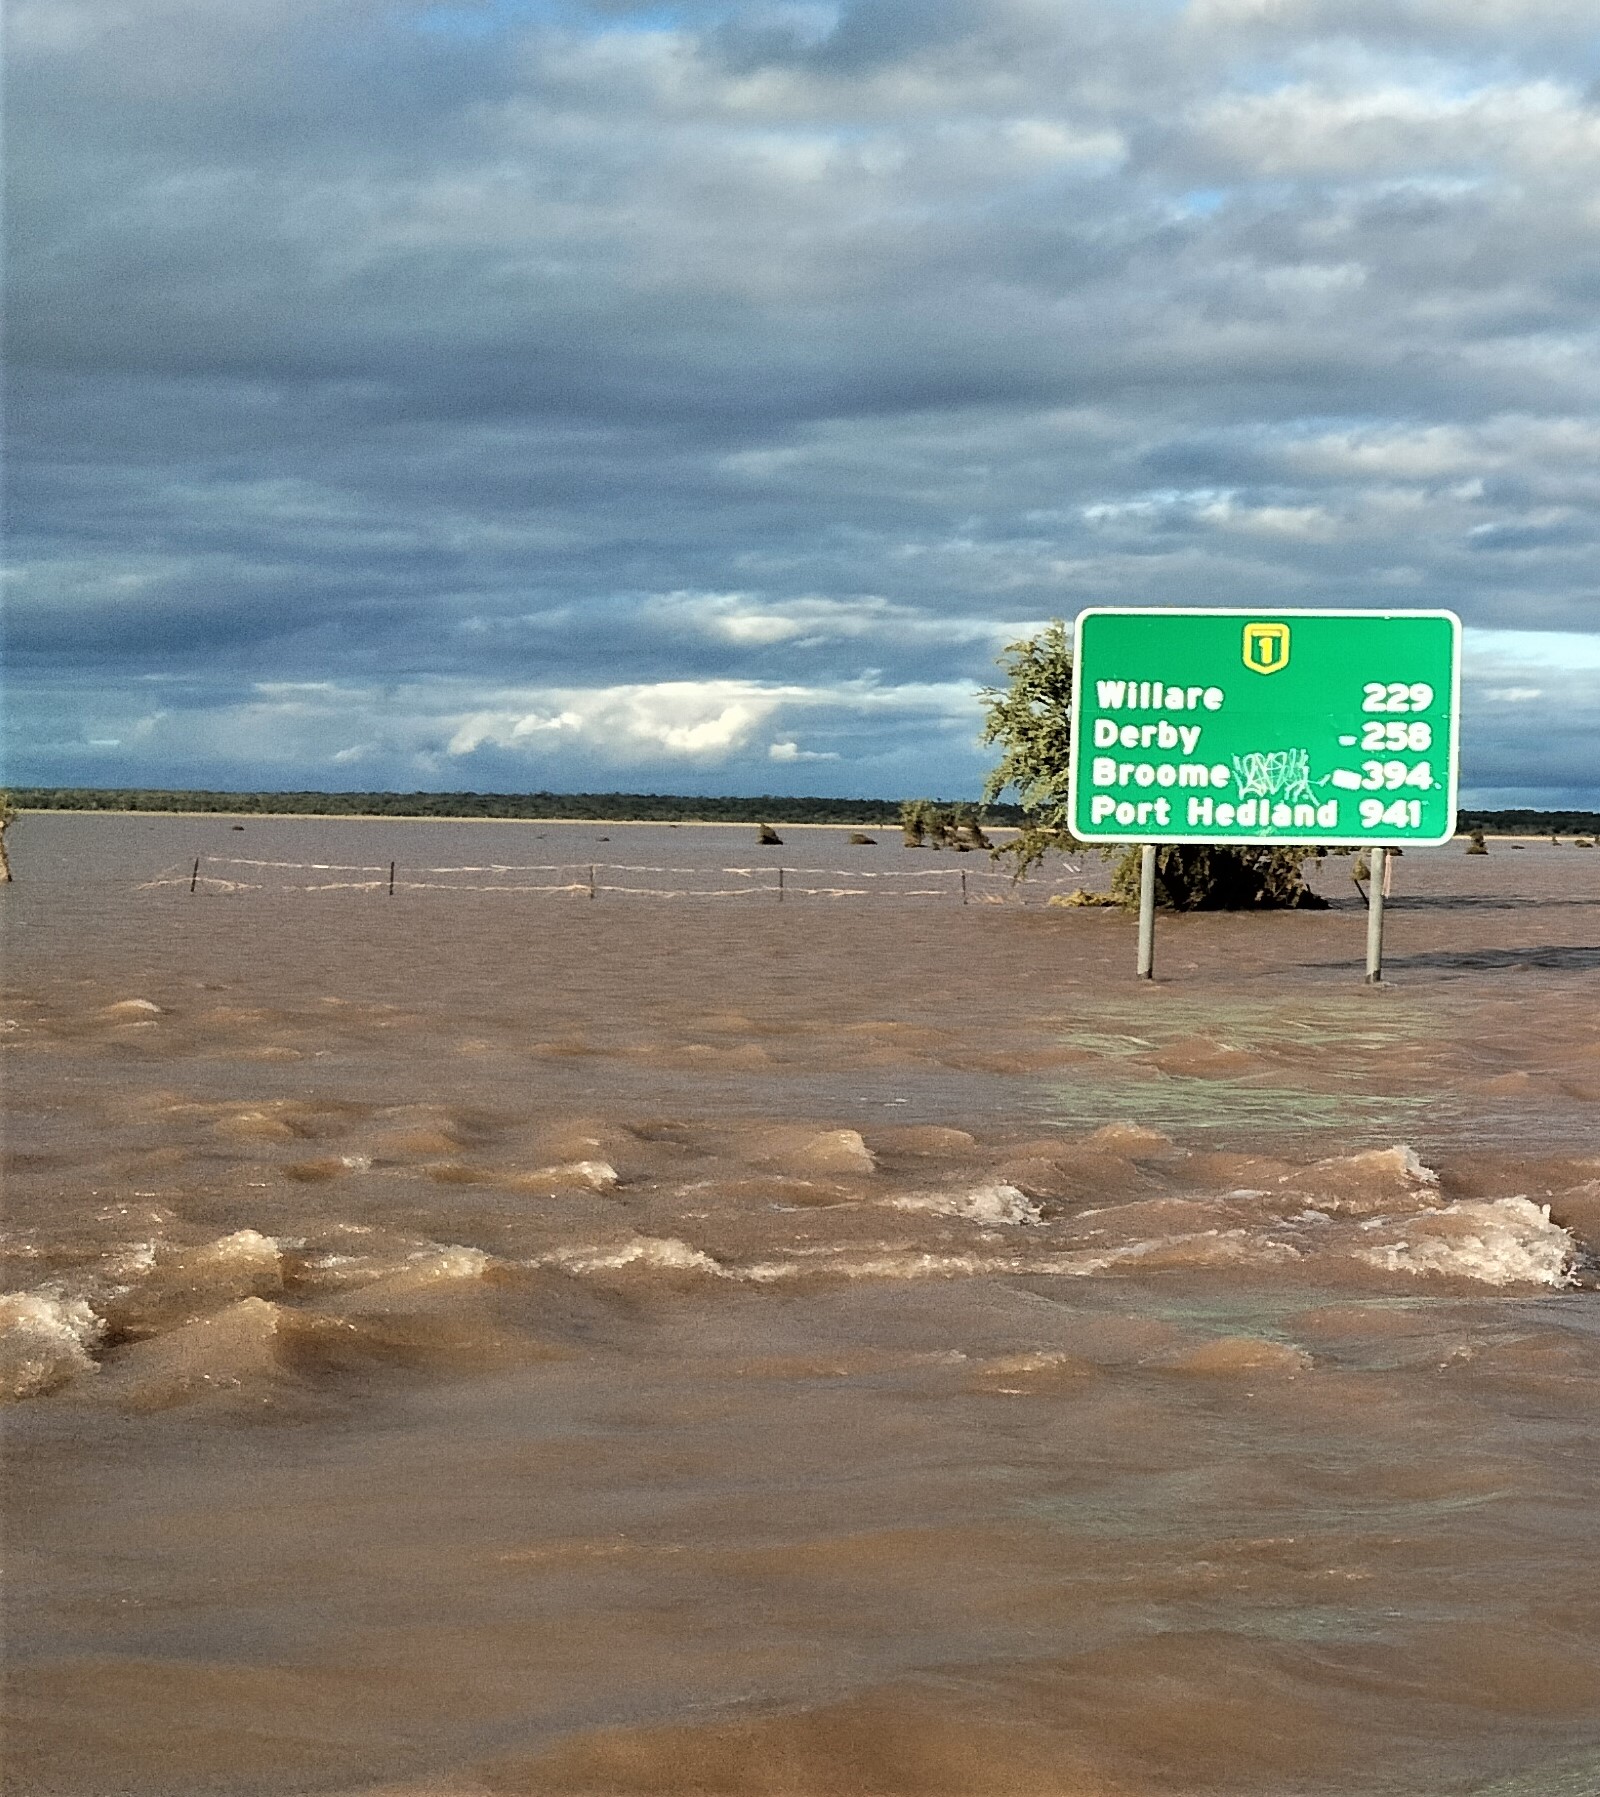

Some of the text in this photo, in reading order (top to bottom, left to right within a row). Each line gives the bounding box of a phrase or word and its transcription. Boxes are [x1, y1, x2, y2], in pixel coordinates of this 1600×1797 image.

[1259, 637, 1272, 664] 1
[1096, 680, 1434, 712] Willare 229
[1094, 718, 1432, 755] Derby 258
[1092, 757, 1230, 788] Broome
[1361, 760, 1432, 790] 394
[1091, 795, 1421, 828] Port Hedland 941
